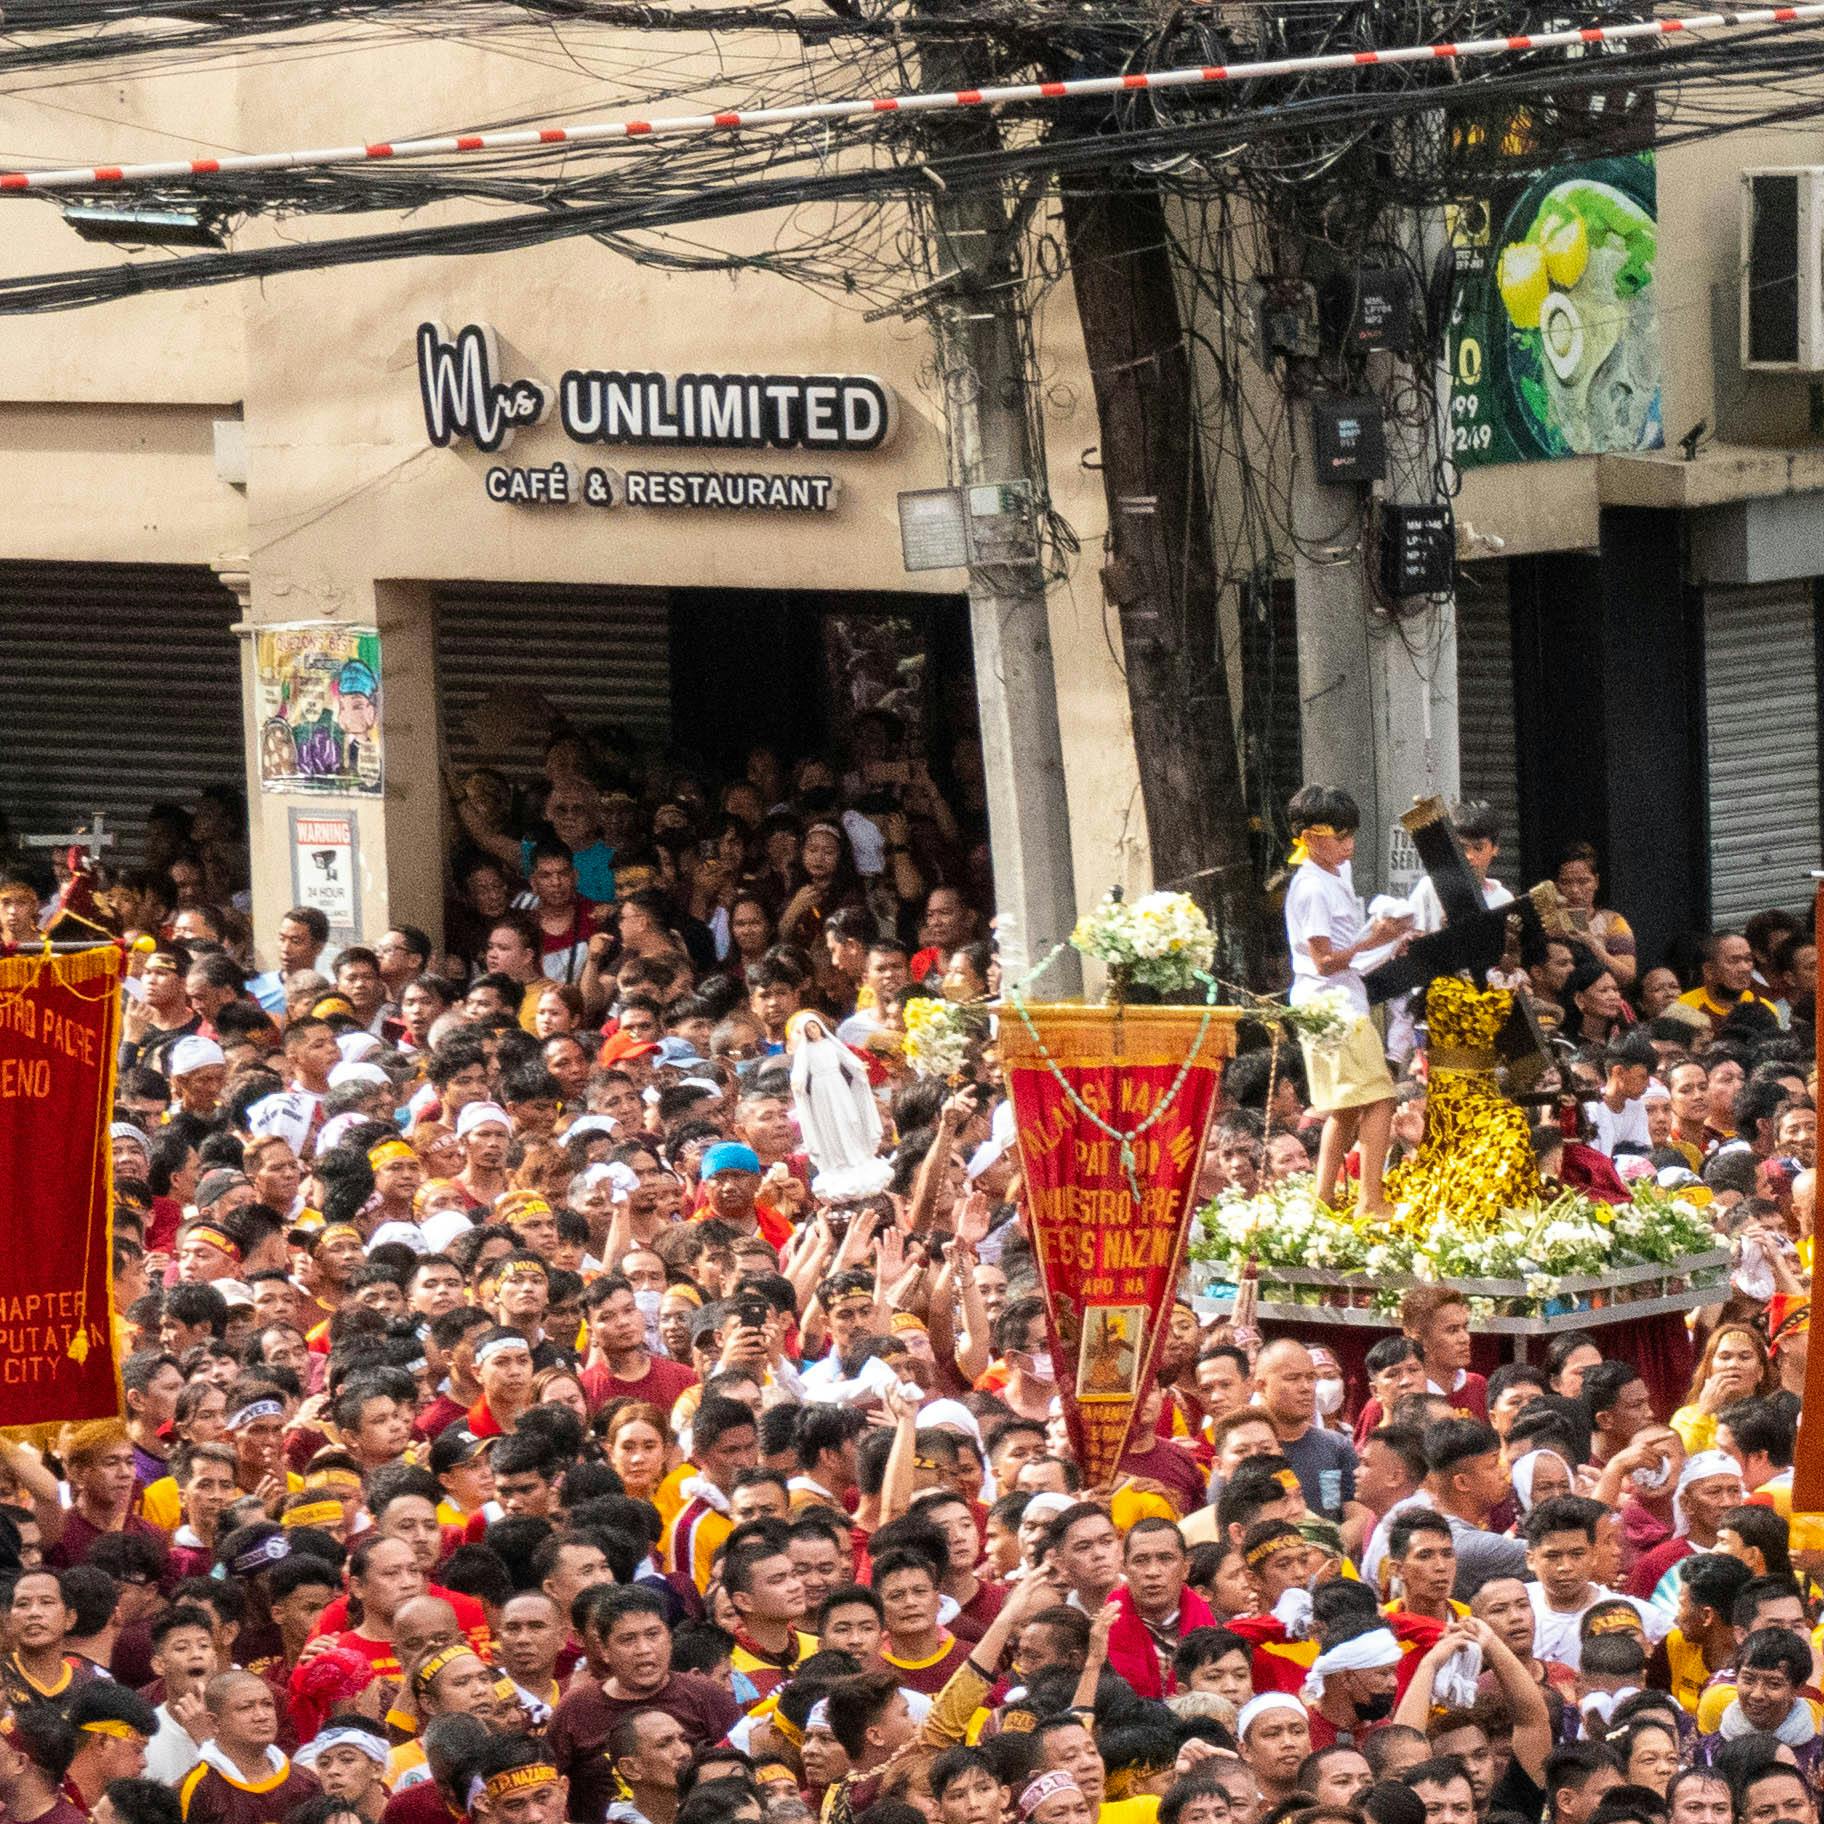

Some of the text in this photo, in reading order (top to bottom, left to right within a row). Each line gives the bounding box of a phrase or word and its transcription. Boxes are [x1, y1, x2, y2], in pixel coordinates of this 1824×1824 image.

[421, 326, 882, 447] Mrs UNLIMITED
[488, 467, 830, 508] CAFÉ & RESTAURANT
[297, 822, 351, 844] WARNING
[3, 1356, 62, 1384] CITY
